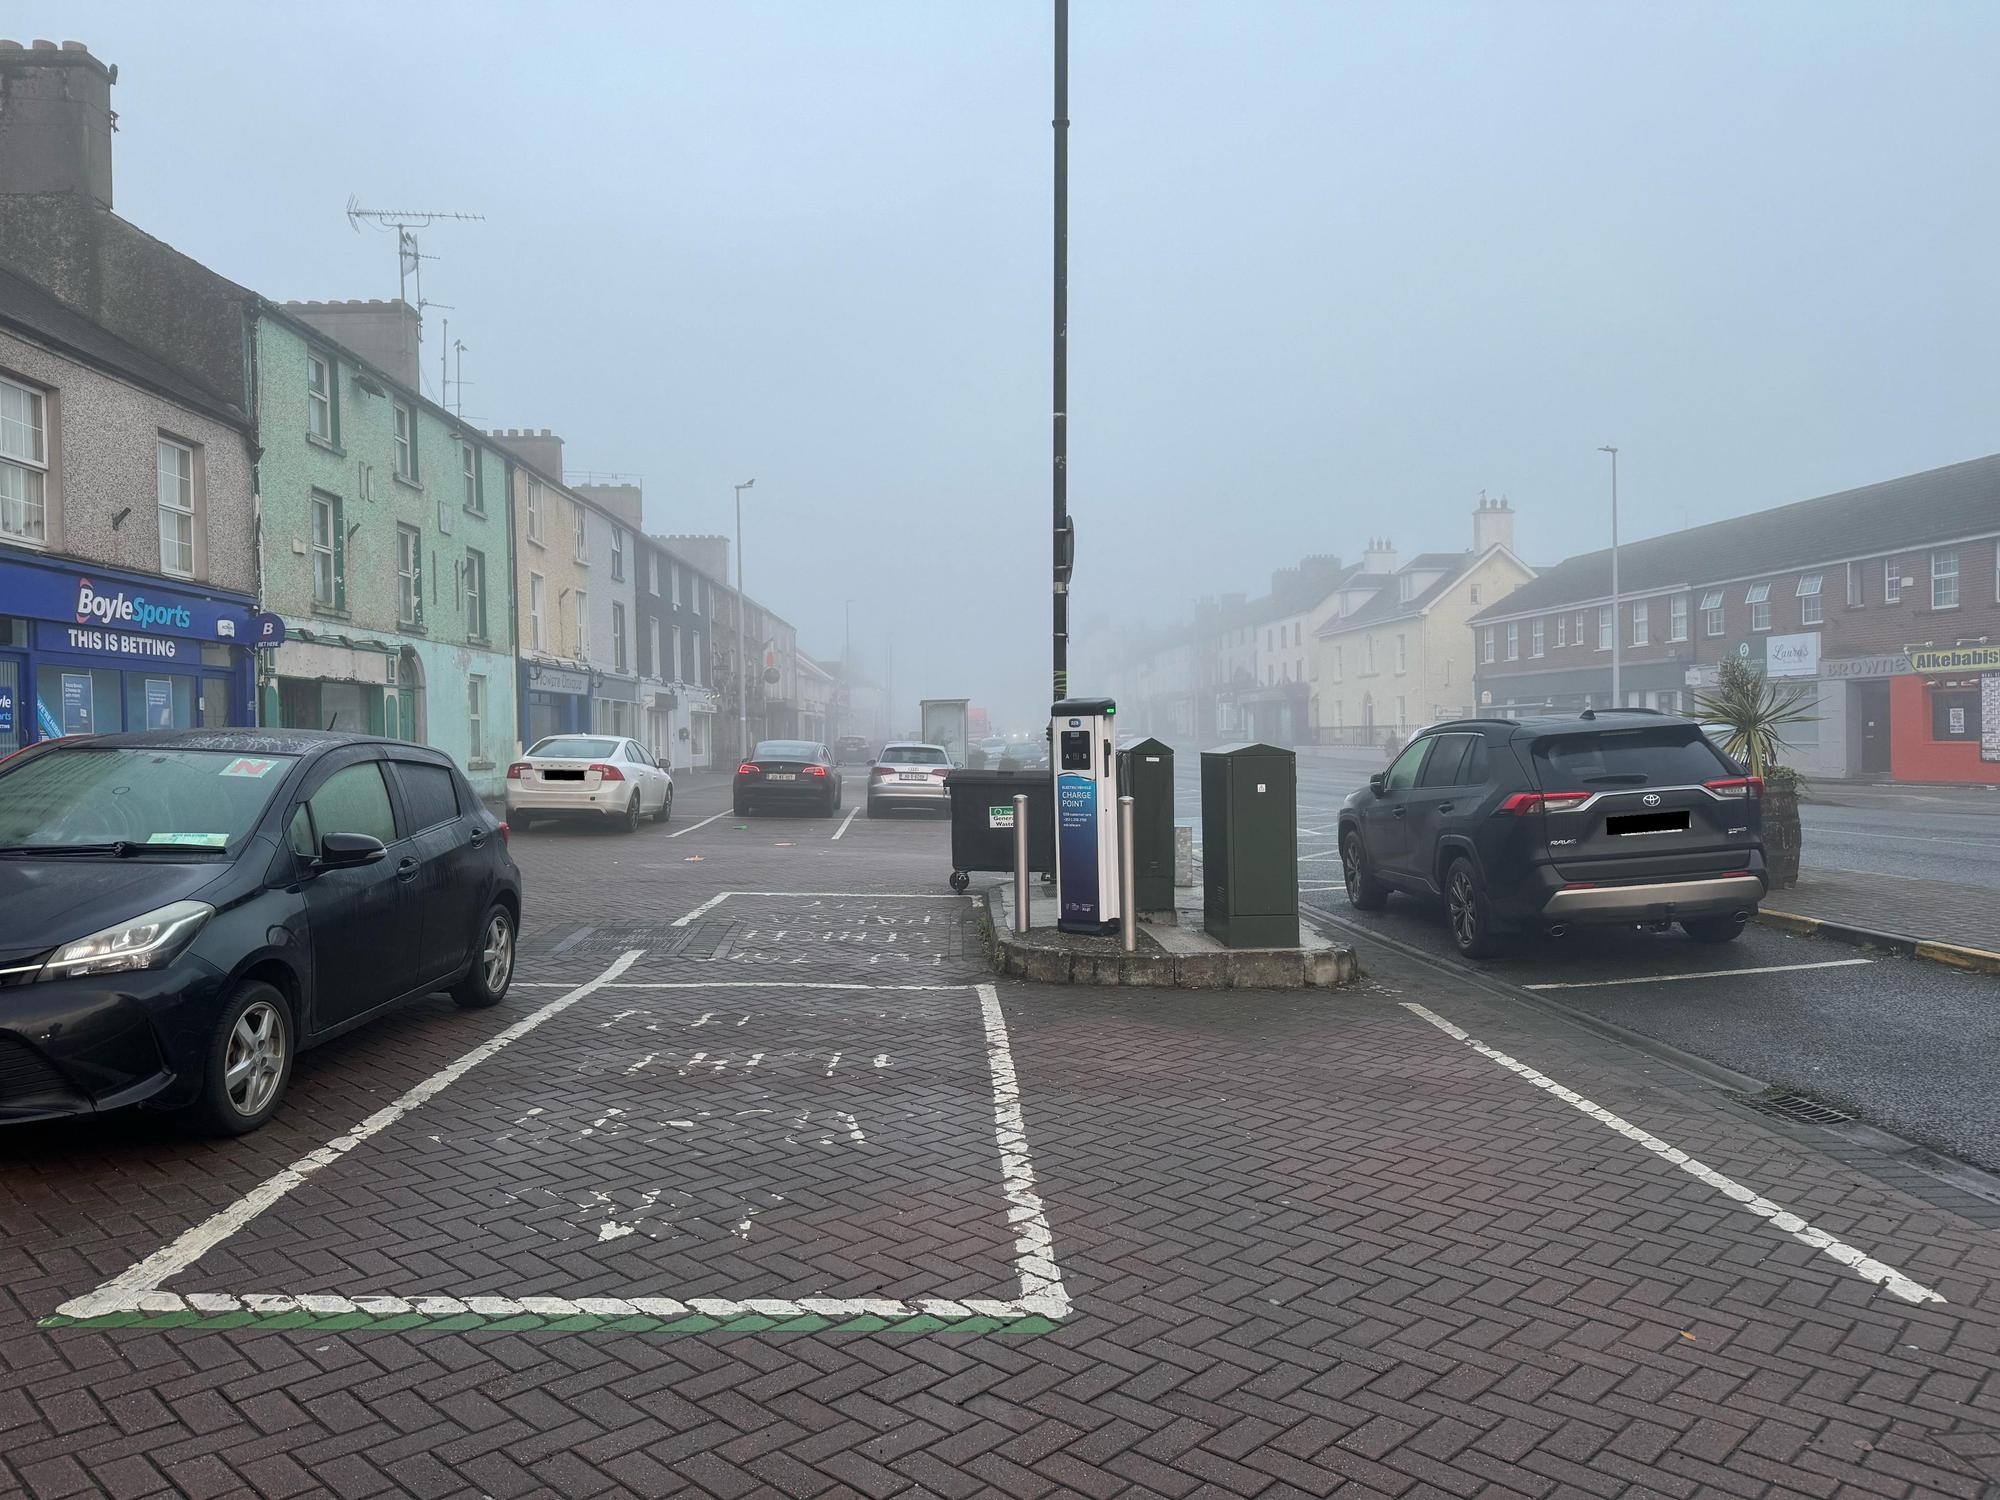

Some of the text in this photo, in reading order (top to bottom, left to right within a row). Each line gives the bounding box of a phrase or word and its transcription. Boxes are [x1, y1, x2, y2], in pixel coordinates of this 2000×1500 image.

[77, 588, 190, 628] BoyleSports
[263, 623, 273, 635] B
[68, 629, 176, 657] THIS IS BETTING
[1916, 650, 2000, 668] Alkebabis
[1062, 791, 1091, 799] CHARGE
